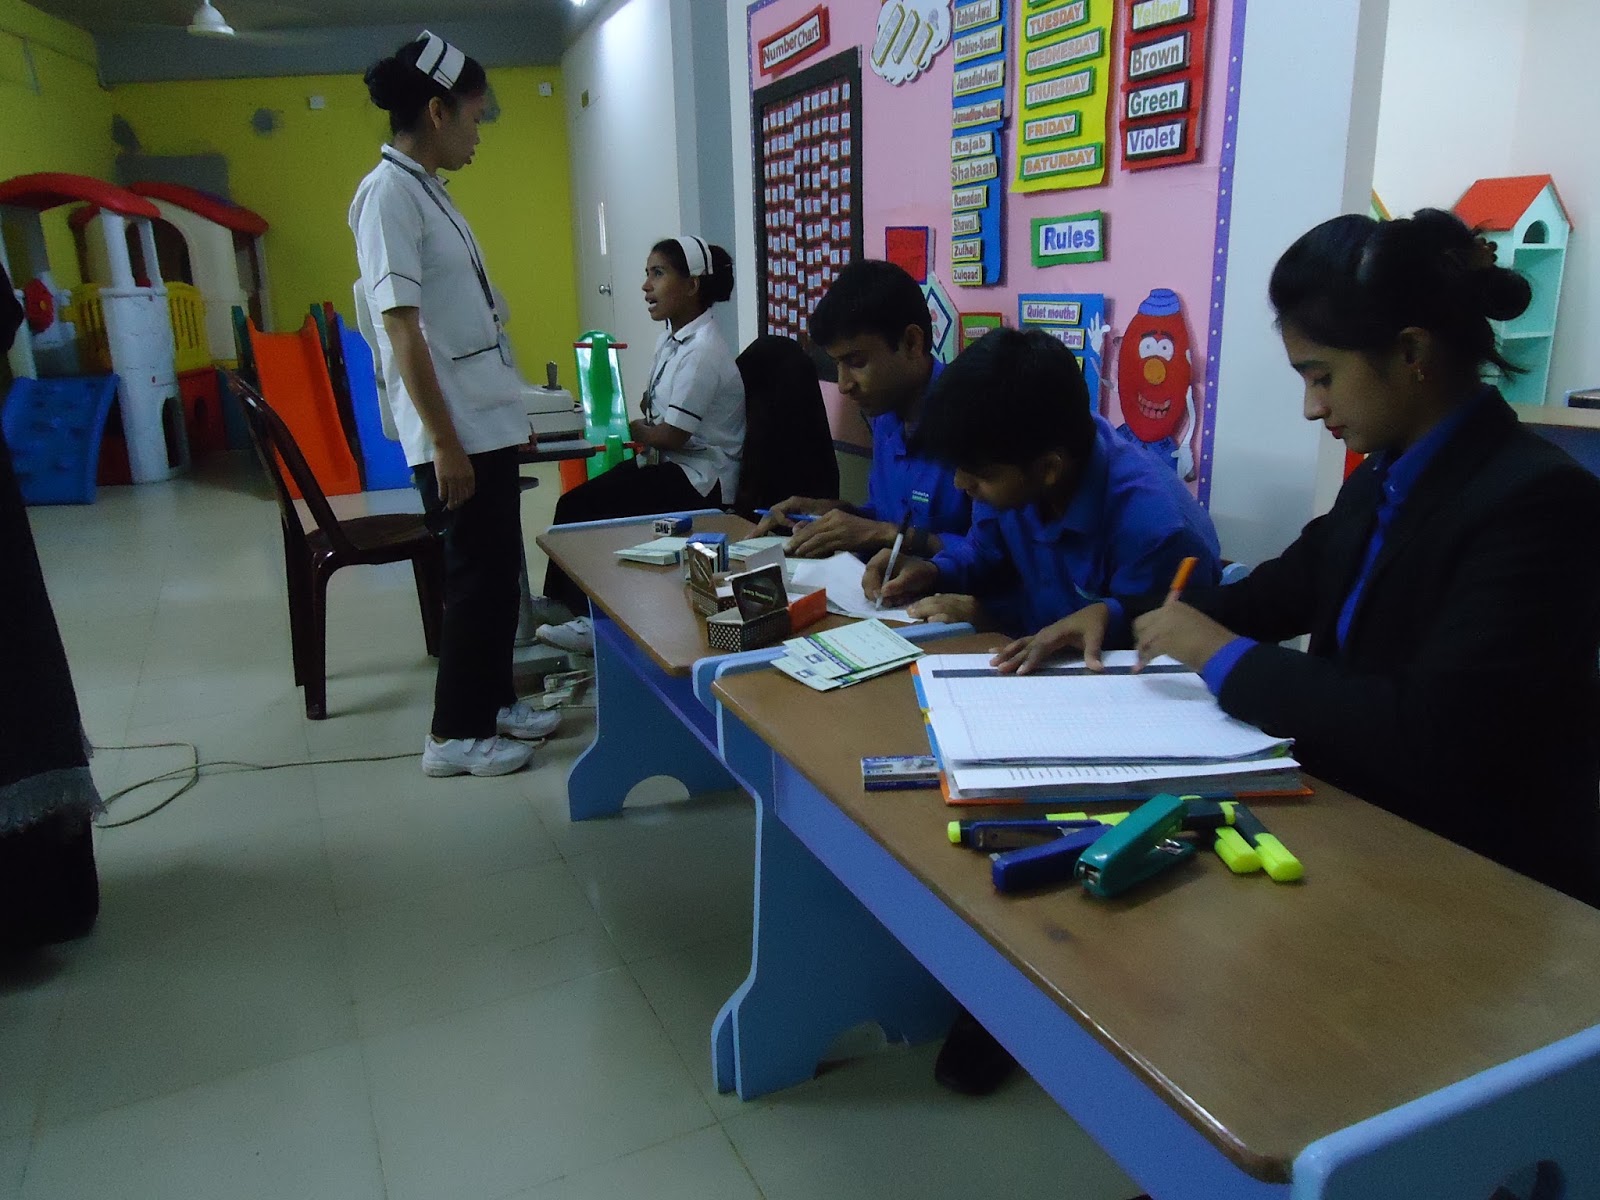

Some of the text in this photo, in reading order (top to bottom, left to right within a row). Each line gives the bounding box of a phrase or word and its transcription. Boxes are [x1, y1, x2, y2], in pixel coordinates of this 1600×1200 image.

[1029, 3, 1083, 35] TUESDAY
[1135, 0, 1181, 28] Yellow
[763, 21, 819, 65] Number Chart
[1028, 32, 1099, 70] WEDNESDAY
[1132, 44, 1180, 73] Brown
[1027, 74, 1090, 103] THURSDAY
[1130, 91, 1178, 116] Green
[1026, 115, 1075, 138] FRIDAY
[955, 136, 986, 154] Rajab
[1129, 126, 1176, 153] Violet
[951, 161, 996, 181] Shabaan
[1024, 149, 1096, 173] SATURDAY
[953, 190, 982, 207] Ramadan
[953, 216, 976, 232] Shawal
[1044, 225, 1096, 251] Rules
[953, 268, 979, 282] Zulqaad
[1026, 304, 1076, 320] Quiet mouths
[1063, 331, 1083, 345] Ears
